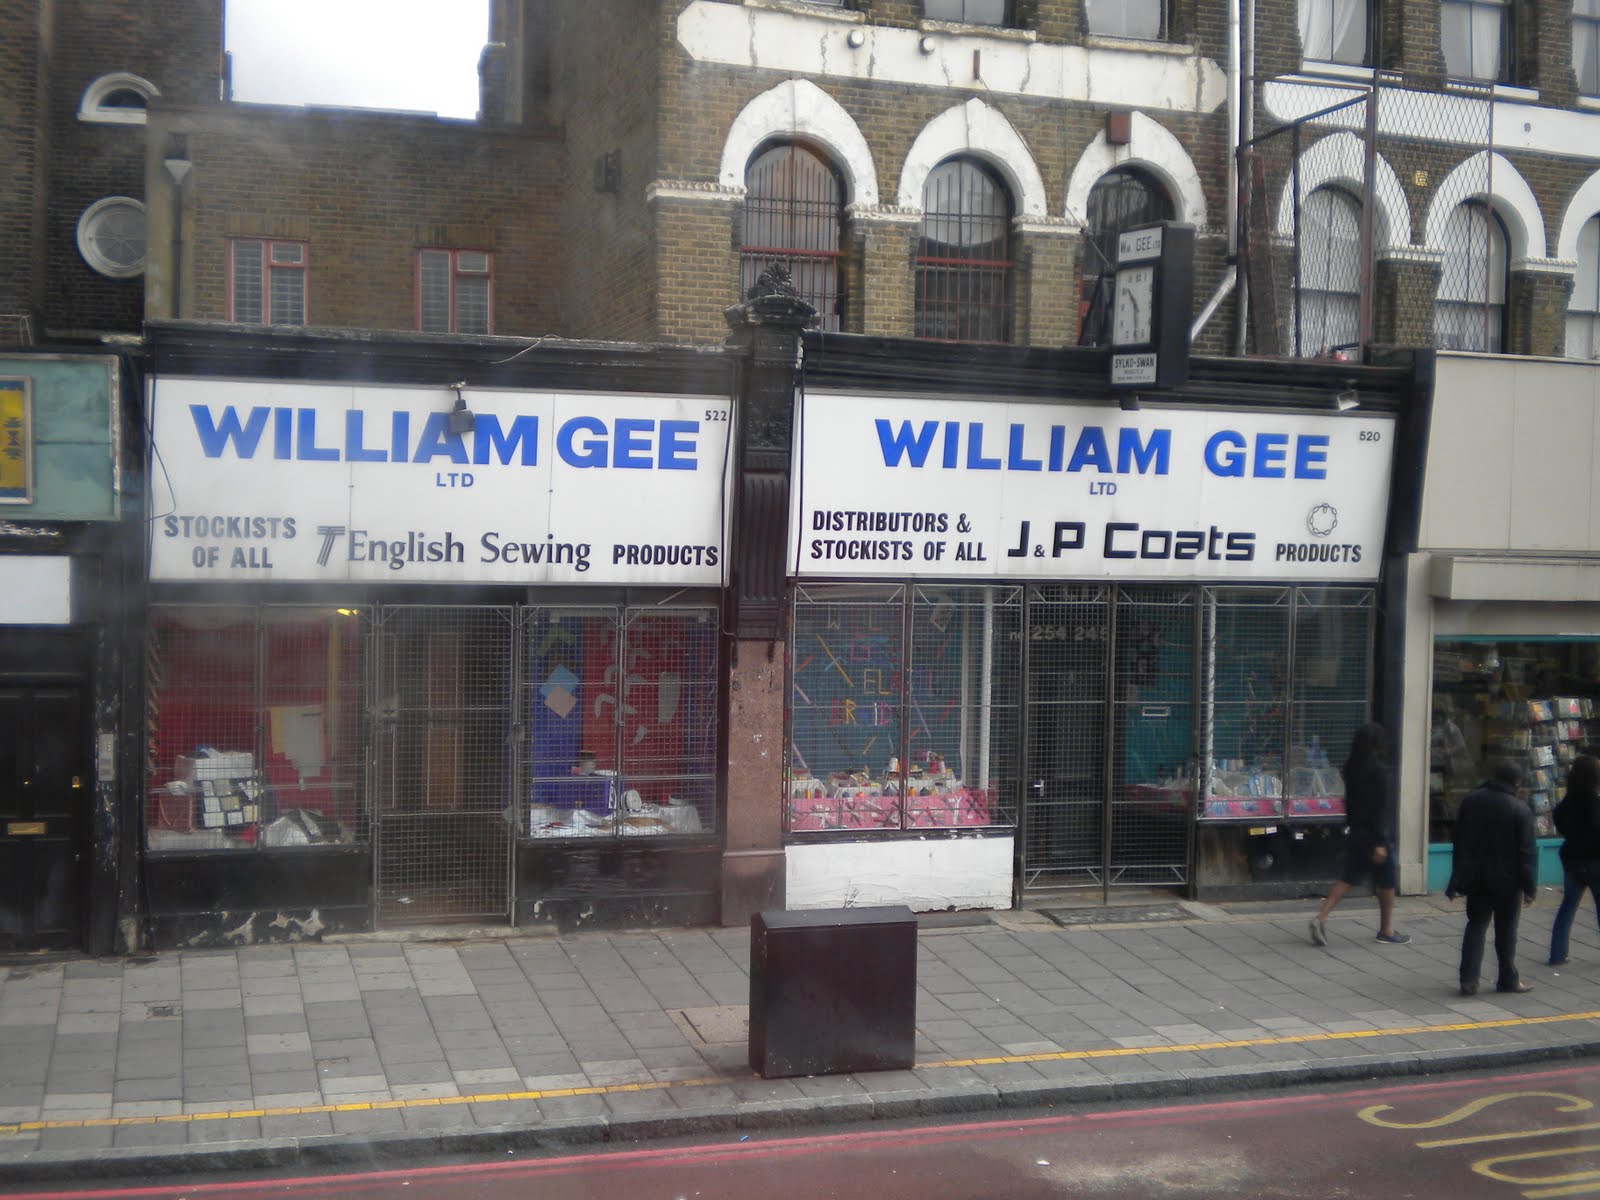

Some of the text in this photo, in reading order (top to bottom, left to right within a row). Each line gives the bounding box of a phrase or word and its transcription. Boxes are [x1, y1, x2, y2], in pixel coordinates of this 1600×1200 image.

[1136, 236, 1152, 252] GEE
[705, 409, 728, 422] 522
[189, 404, 700, 471] WILLIAM GEE
[1359, 430, 1381, 442] 520
[874, 418, 1330, 480] WILLIAM GEE
[436, 472, 475, 488] LTD
[1089, 481, 1118, 496] LTD
[164, 515, 297, 540] STOCKISTS
[812, 510, 972, 533] DISTRIBUTORS &
[347, 530, 465, 571] English
[480, 531, 592, 573] Sewing
[810, 539, 987, 562] STOCKISTS OF ALL
[1103, 522, 1256, 562] Coats
[1275, 543, 1362, 563] PRODUCTS
[192, 546, 273, 569] OF ALL
[612, 544, 719, 567] PRODUCTS
